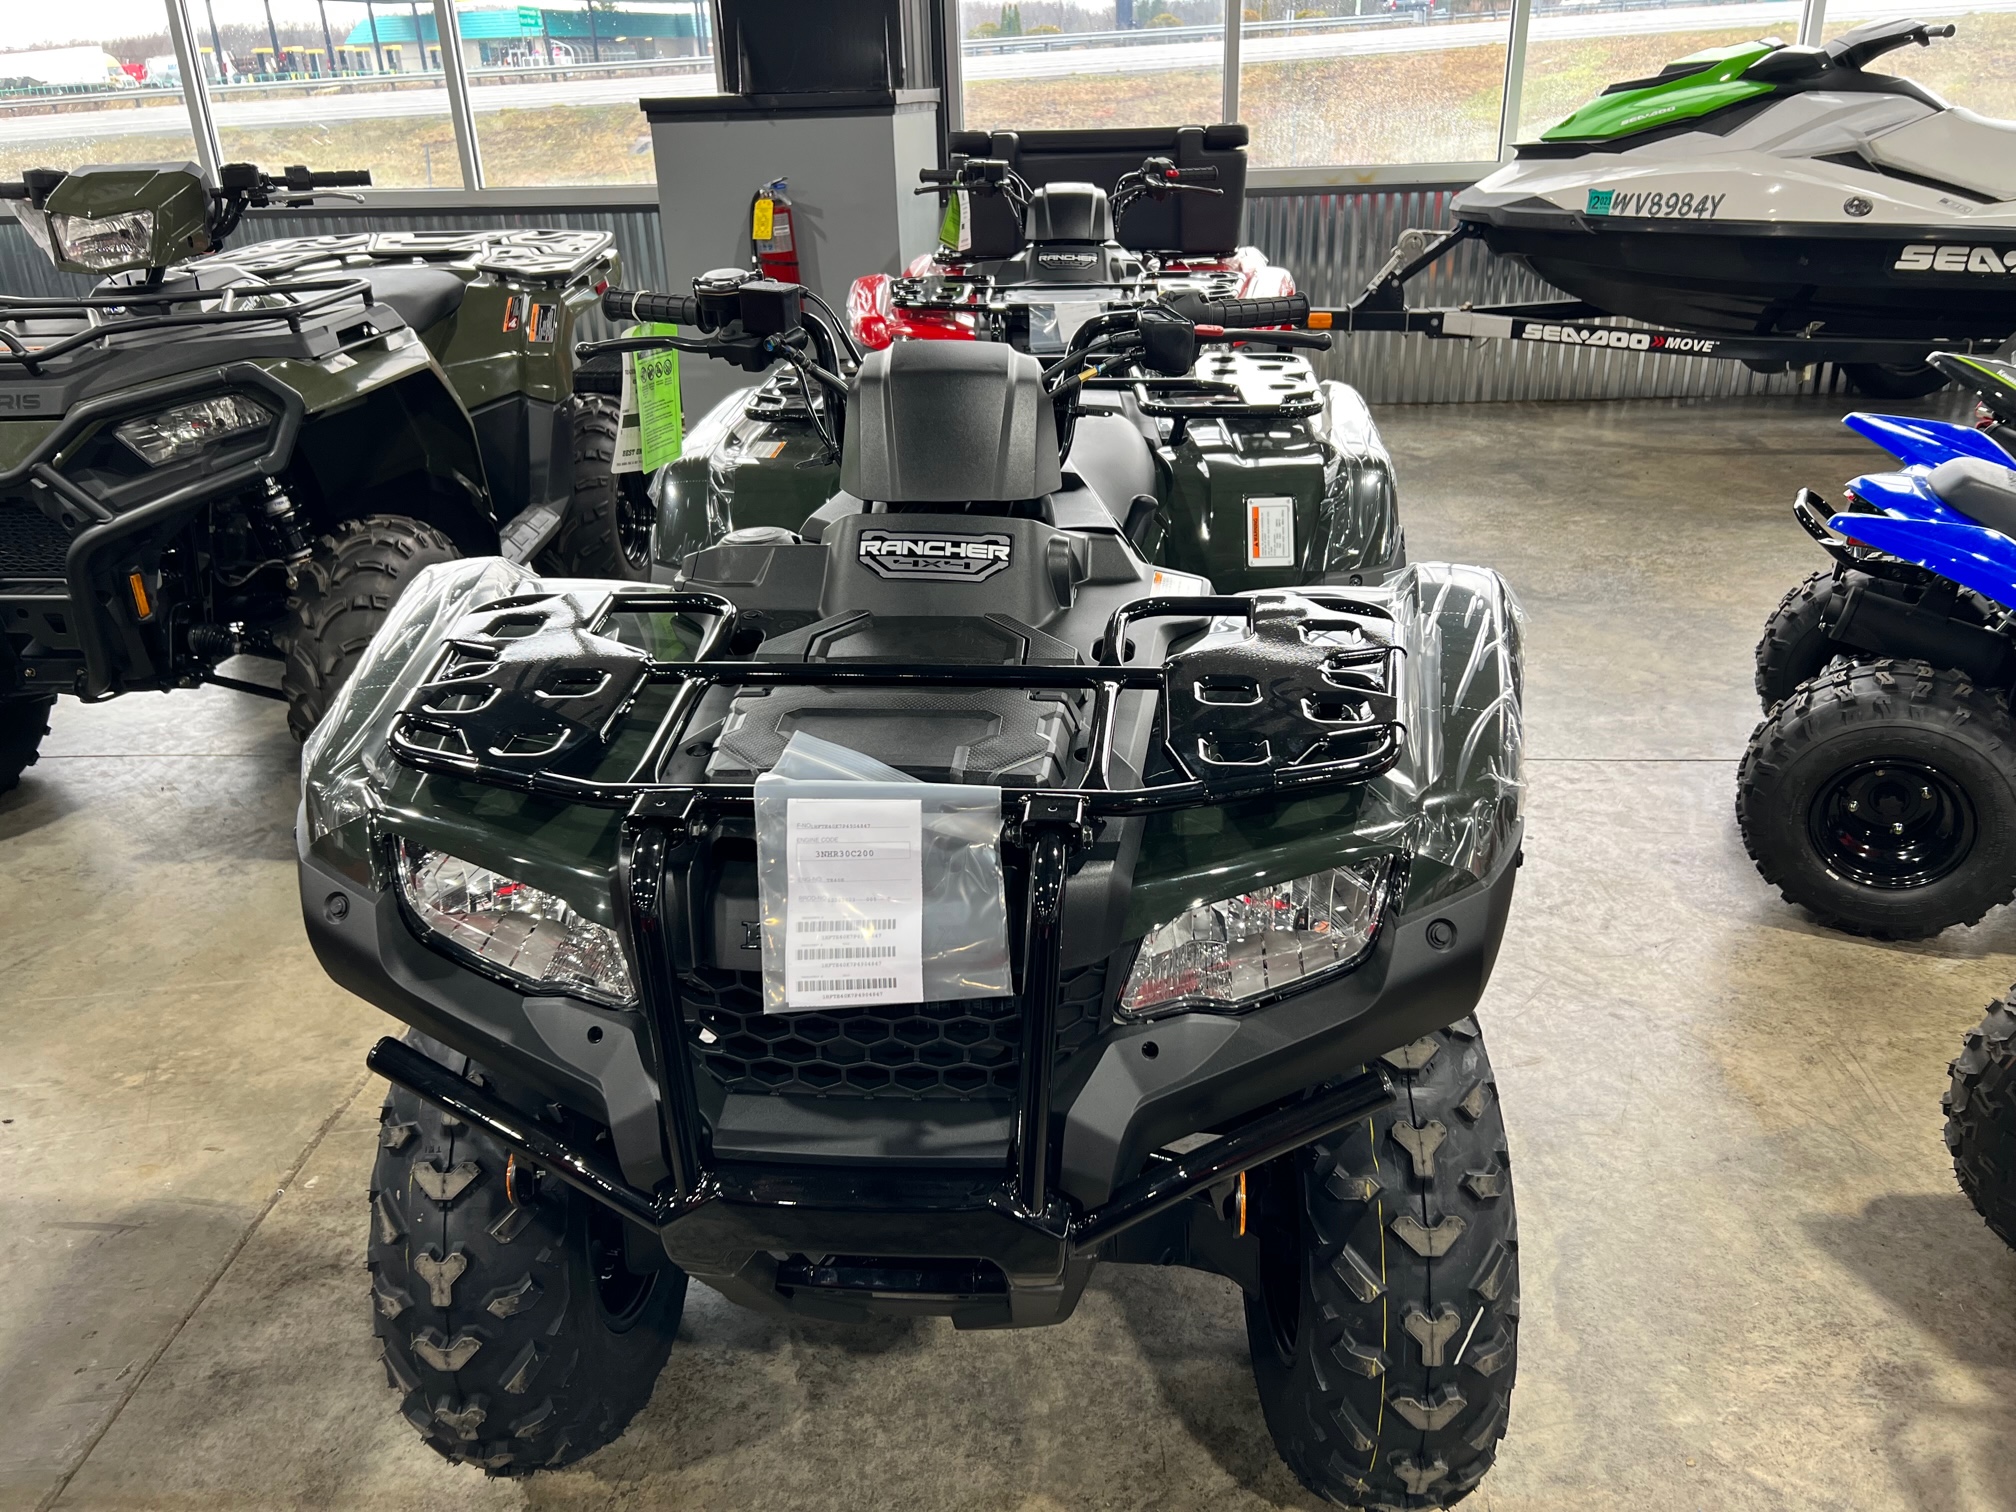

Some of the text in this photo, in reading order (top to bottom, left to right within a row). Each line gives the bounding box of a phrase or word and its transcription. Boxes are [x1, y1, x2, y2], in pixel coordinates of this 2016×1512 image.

[1611, 192, 1726, 219] WV8984Y
[1038, 254, 1098, 263] RANCHER
[1664, 336, 1714, 353] MOVE
[859, 540, 1011, 561] RANCHER
[815, 849, 875, 858] 3NHR30C200
